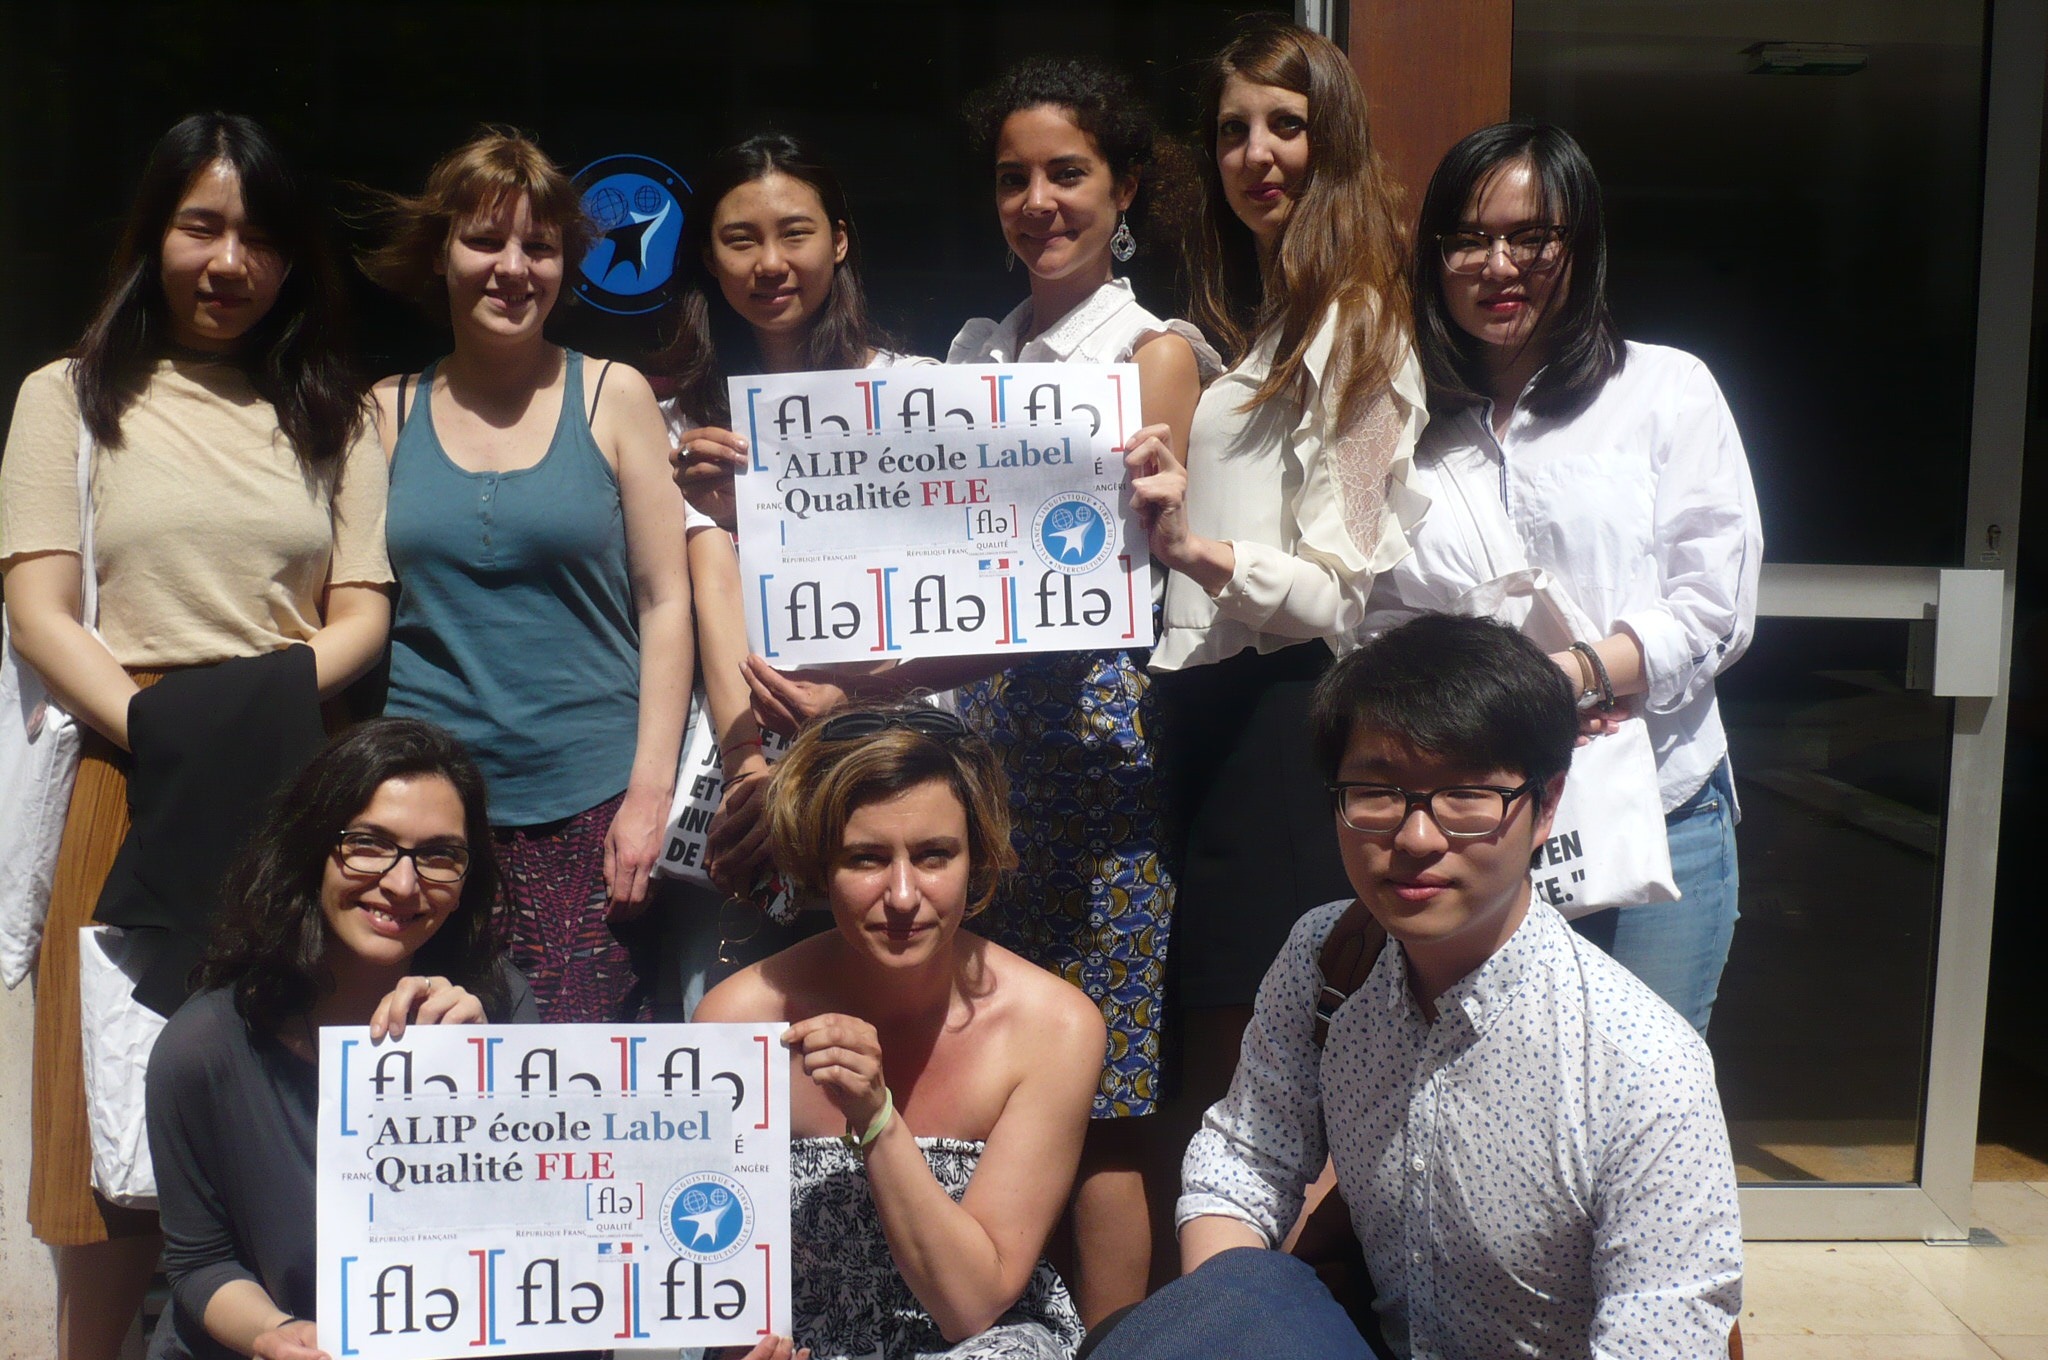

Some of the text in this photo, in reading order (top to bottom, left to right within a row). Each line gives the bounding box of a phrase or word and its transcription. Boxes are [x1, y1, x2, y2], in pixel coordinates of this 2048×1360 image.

[784, 437, 1074, 479] ALIP école Label
[785, 478, 991, 520] Qualité FLE
[976, 540, 1009, 551] QUALITÉ
[690, 774, 721, 801] ET
[665, 836, 701, 867] DE
[374, 1110, 711, 1146] ALIP école Label
[375, 1152, 615, 1193] Qualité FLE
[669, 1174, 728, 1200] LINGUISTIQUE
[596, 1222, 633, 1233] QUALITÉ
